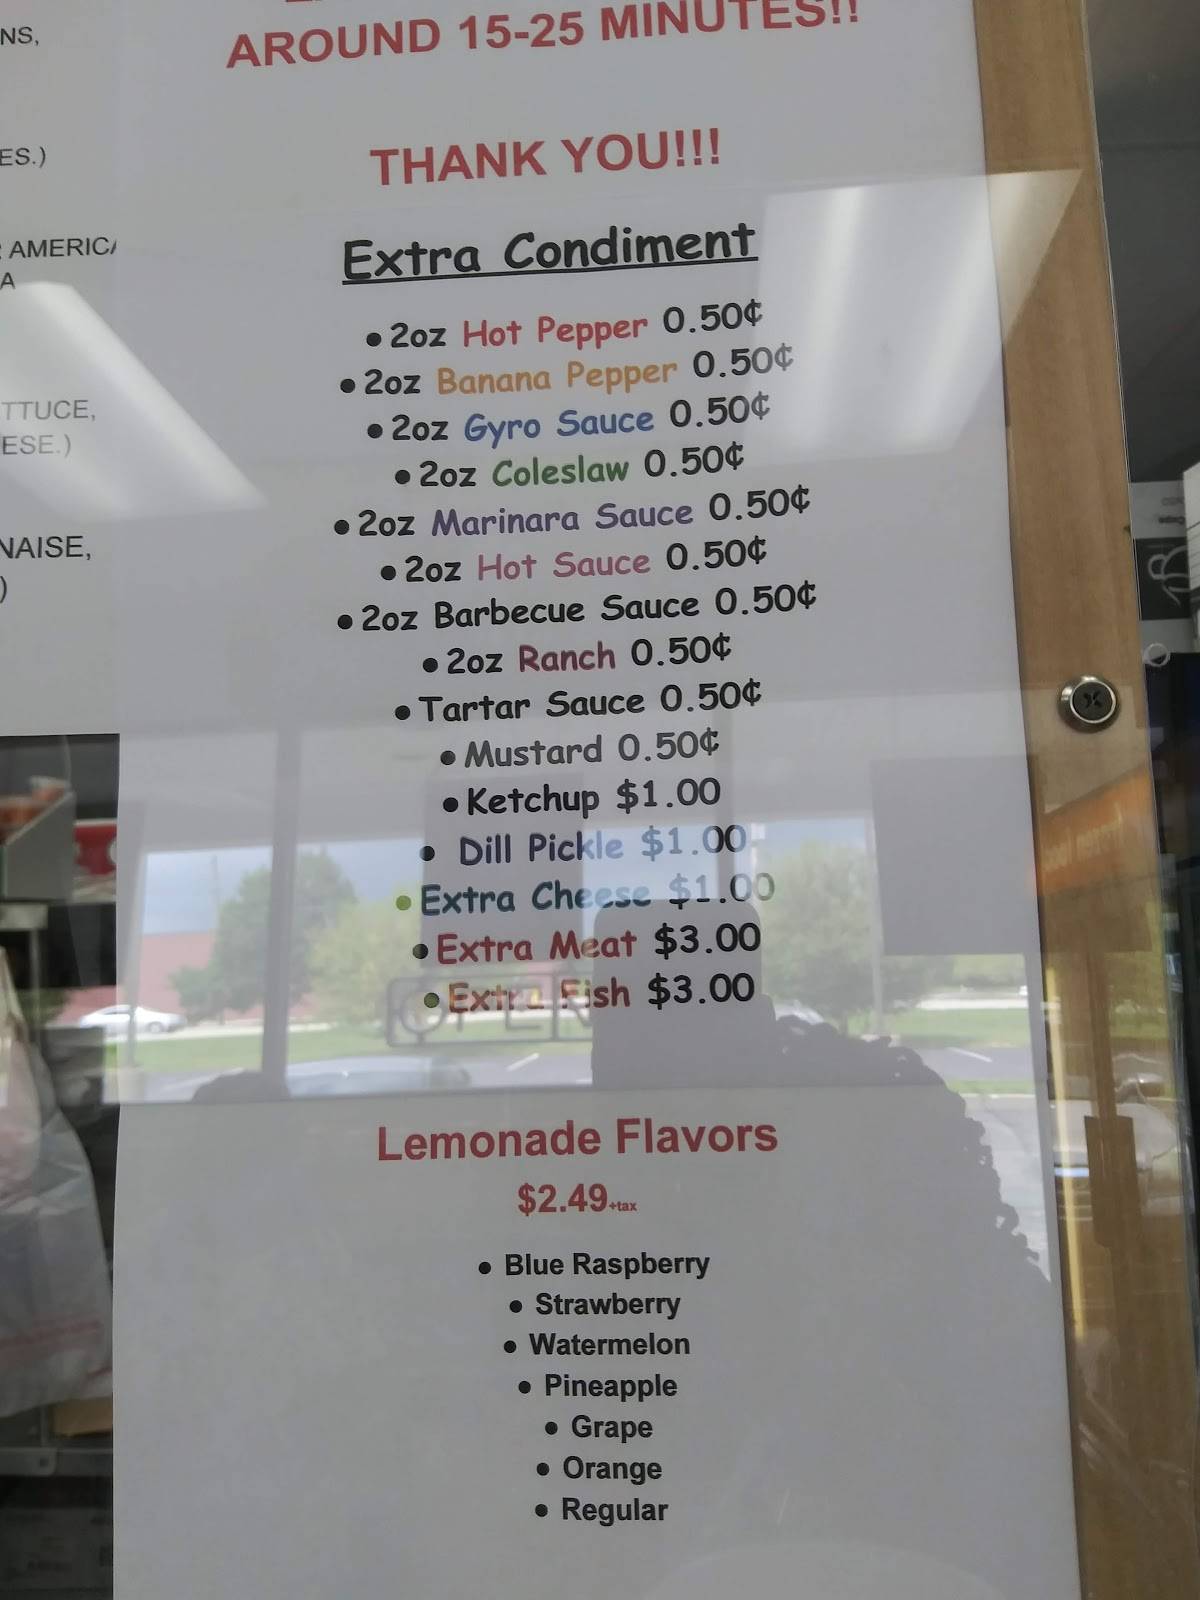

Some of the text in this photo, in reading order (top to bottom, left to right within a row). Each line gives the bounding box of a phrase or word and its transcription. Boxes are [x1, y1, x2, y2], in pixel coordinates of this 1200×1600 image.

[0, 26, 39, 46] NS,
[226, 0, 858, 68] AROUND 15-25 MINUTES!!
[369, 128, 720, 186] THANK YOU!!!
[343, 222, 756, 281] Extra Condiment
[390, 298, 763, 350] 2oz Hot Pepper 0.50¢
[364, 343, 793, 395] 2oz Banana Pepper 0.50¢
[392, 391, 770, 449] 2oz Gyro Sauce 0.50¢
[419, 441, 744, 487] 2oz Coleslaw 0.50¢
[358, 484, 811, 537] 2oz Marinara Sauce 0.50¢
[405, 535, 767, 583] 2oz Hot Sauce 0.50¢
[362, 580, 817, 631] 2oz Barbecue Sauce 0.50¢
[447, 632, 732, 675] 2oz Ranch 0.50¢
[419, 678, 762, 722] Tartar Sauce 0.50¢
[465, 728, 719, 769] Mustard 0.50¢
[467, 777, 721, 818] Ketchup $1.00
[460, 825, 747, 866] Dill Pickle $1.00
[421, 872, 775, 916] Extra Cheese $1.00
[437, 922, 761, 965] Extra Meat $3.00
[561, 977, 630, 1009] Fish
[648, 972, 755, 1010] $3.00
[378, 1118, 778, 1161] Lemonade Flavors
[505, 1252, 710, 1280] Blue Raspberry
[535, 1292, 681, 1320] Strawberry
[529, 1332, 690, 1355] Watermelon
[545, 1373, 678, 1402] Pineapple
[571, 1415, 653, 1443] Grape
[563, 1455, 663, 1486] Orange
[562, 1497, 669, 1527] Regular
